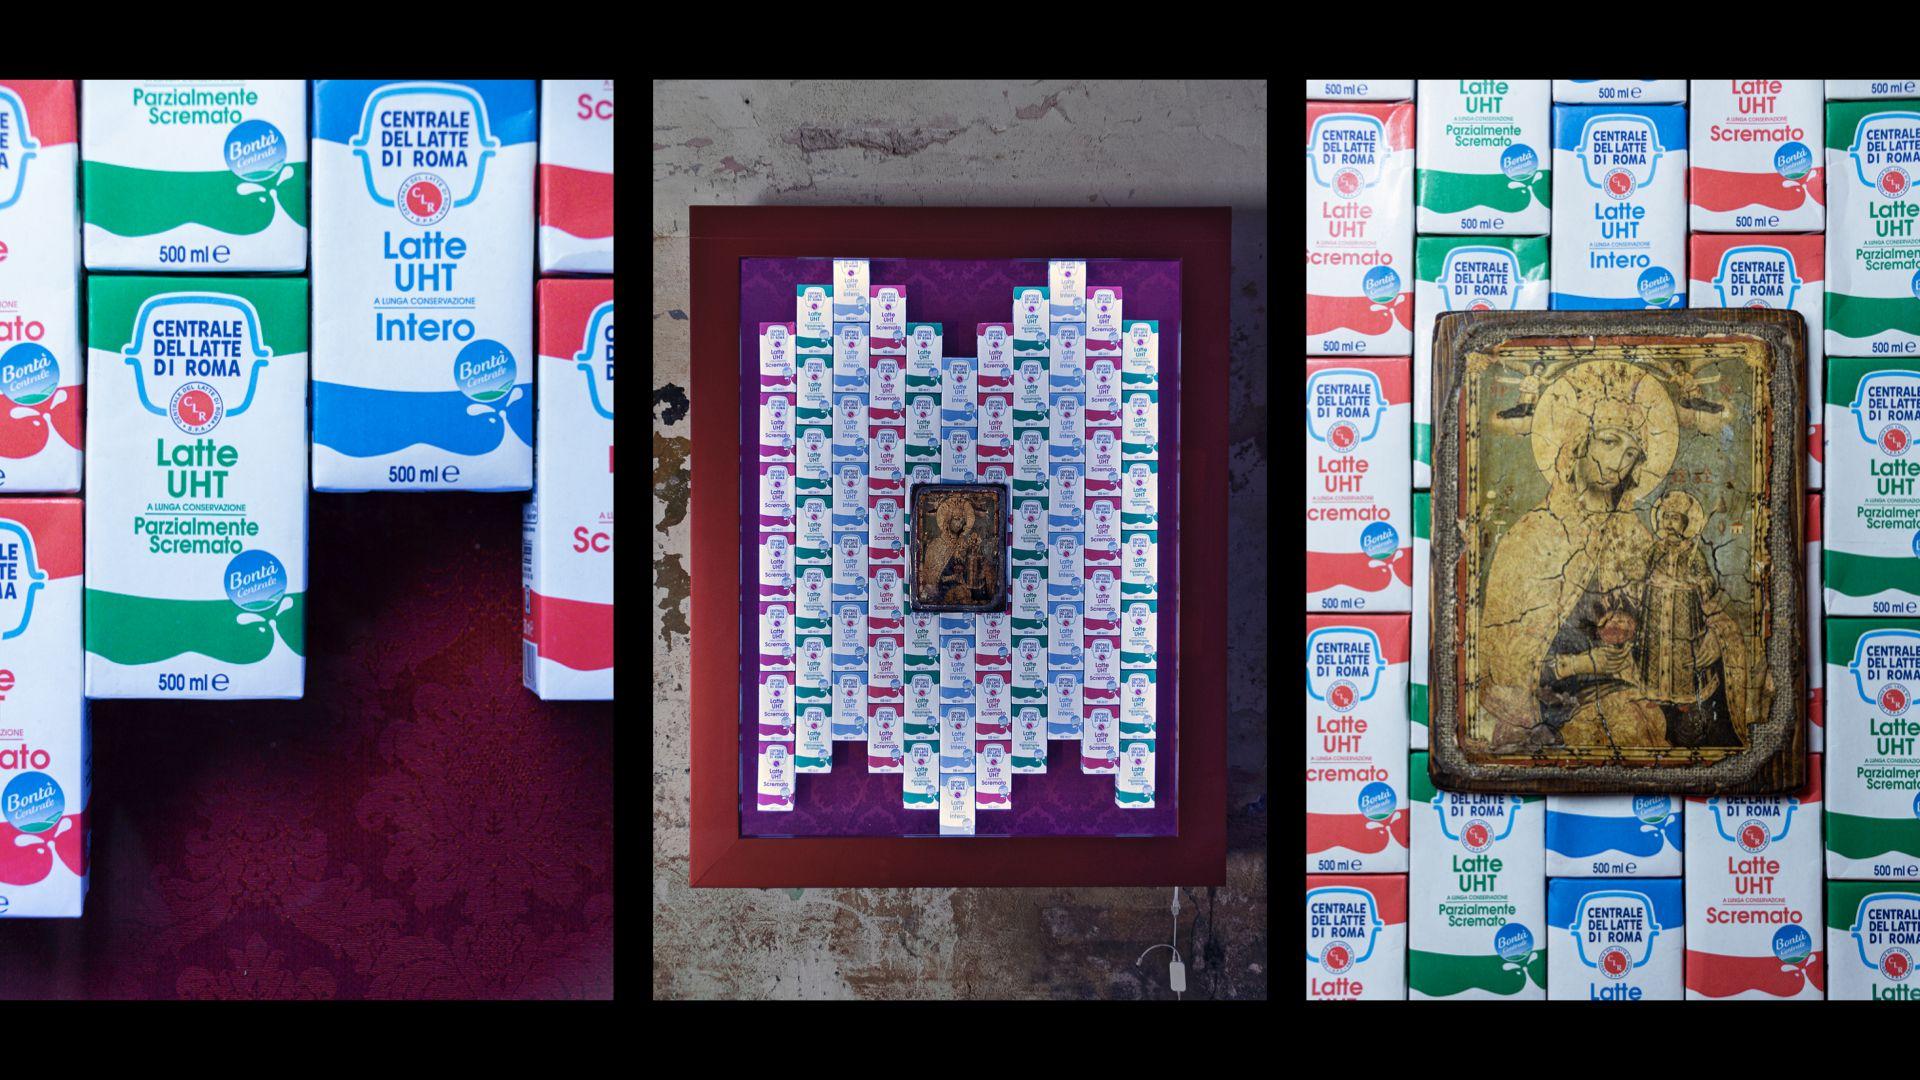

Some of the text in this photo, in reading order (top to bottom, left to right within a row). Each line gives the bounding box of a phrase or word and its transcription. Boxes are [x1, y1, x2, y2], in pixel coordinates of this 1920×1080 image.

[1460, 80, 1508, 95] Latte
[1599, 88, 1628, 98] 500 ml
[1732, 80, 1782, 94] Latte
[134, 89, 257, 106] Parzialmente
[1466, 97, 1502, 113] UHT
[1738, 97, 1776, 114] UHT
[150, 108, 242, 124] Scremato
[381, 111, 469, 128] CENTRALE
[382, 131, 468, 147] DEL LATTE
[1446, 125, 1521, 136] Parzialmente
[1593, 131, 1647, 141] CENTRALE
[1710, 126, 1804, 142] Scremato
[229, 130, 278, 160] Bontà
[1455, 136, 1512, 147] Scremato
[1594, 143, 1646, 153] DEL LATTE
[1867, 141, 1886, 151] DEL
[236, 147, 276, 169] Centrale
[382, 150, 468, 167] DI ROMA
[1594, 155, 1646, 164] DI ROMA
[1868, 154, 1879, 163] DI
[1595, 203, 1645, 220] Latte
[1870, 201, 1919, 218] Latte
[1461, 219, 1492, 229] 500 ml
[1736, 216, 1766, 227] 500 ml
[1876, 220, 1913, 237] UHT
[1602, 222, 1639, 239] UHT
[384, 231, 466, 260] Latte
[159, 246, 208, 263] 500 ml
[1590, 251, 1650, 268] Intero
[395, 263, 456, 292] UHT
[153, 320, 242, 337] CENTRALE
[376, 313, 475, 341] Intero
[154, 340, 241, 357] DEL LATTE
[1872, 342, 1902, 352] 500 ml
[2, 352, 51, 383] Bontà
[154, 359, 240, 376] DI ROMA
[459, 350, 508, 380] Bontà
[10, 369, 50, 391] Centrale
[467, 366, 506, 388] Centrale
[1317, 384, 1371, 394] CENTRALE
[1317, 396, 1370, 406] DEL LATTE
[1318, 408, 1370, 418] DI ROMA
[157, 439, 238, 467] Latte
[1318, 456, 1368, 473] Latte
[389, 465, 438, 483] 500 ml
[168, 470, 228, 498] UHT
[1325, 475, 1362, 492] UHT
[182, 503, 246, 511] CONSERVAZIONE
[134, 516, 258, 536] Parzialmente
[150, 536, 242, 554] Scremato
[229, 560, 278, 591] Bontà
[237, 578, 276, 599] Centrale
[1316, 643, 1370, 653] CENTRALE
[1317, 655, 1369, 664] DEL LATTE
[1868, 658, 1887, 668] DEL
[1317, 667, 1369, 677] DI ROMA
[1868, 670, 1879, 680] DI
[158, 674, 207, 691] 500 ml
[1317, 716, 1368, 733] Latte
[1323, 736, 1361, 752] UHT
[1877, 738, 1914, 755] UHT
[7, 783, 55, 812] Bontà
[1451, 794, 1504, 804] DEL LATTE
[15, 799, 54, 820] Centrale
[1452, 806, 1504, 816] DI ROMA
[1727, 806, 1780, 816] DI ROMA
[1319, 860, 1348, 870] 500 ml
[1453, 855, 1502, 872] Latte
[1728, 857, 1780, 874] Latte
[1874, 866, 1905, 876] 500 ml
[1459, 875, 1496, 892] UHT
[1736, 878, 1774, 894] UHT
[1439, 904, 1516, 915] Parzialmente
[1707, 908, 1802, 924] Scremato
[1448, 916, 1506, 927] Scremato
